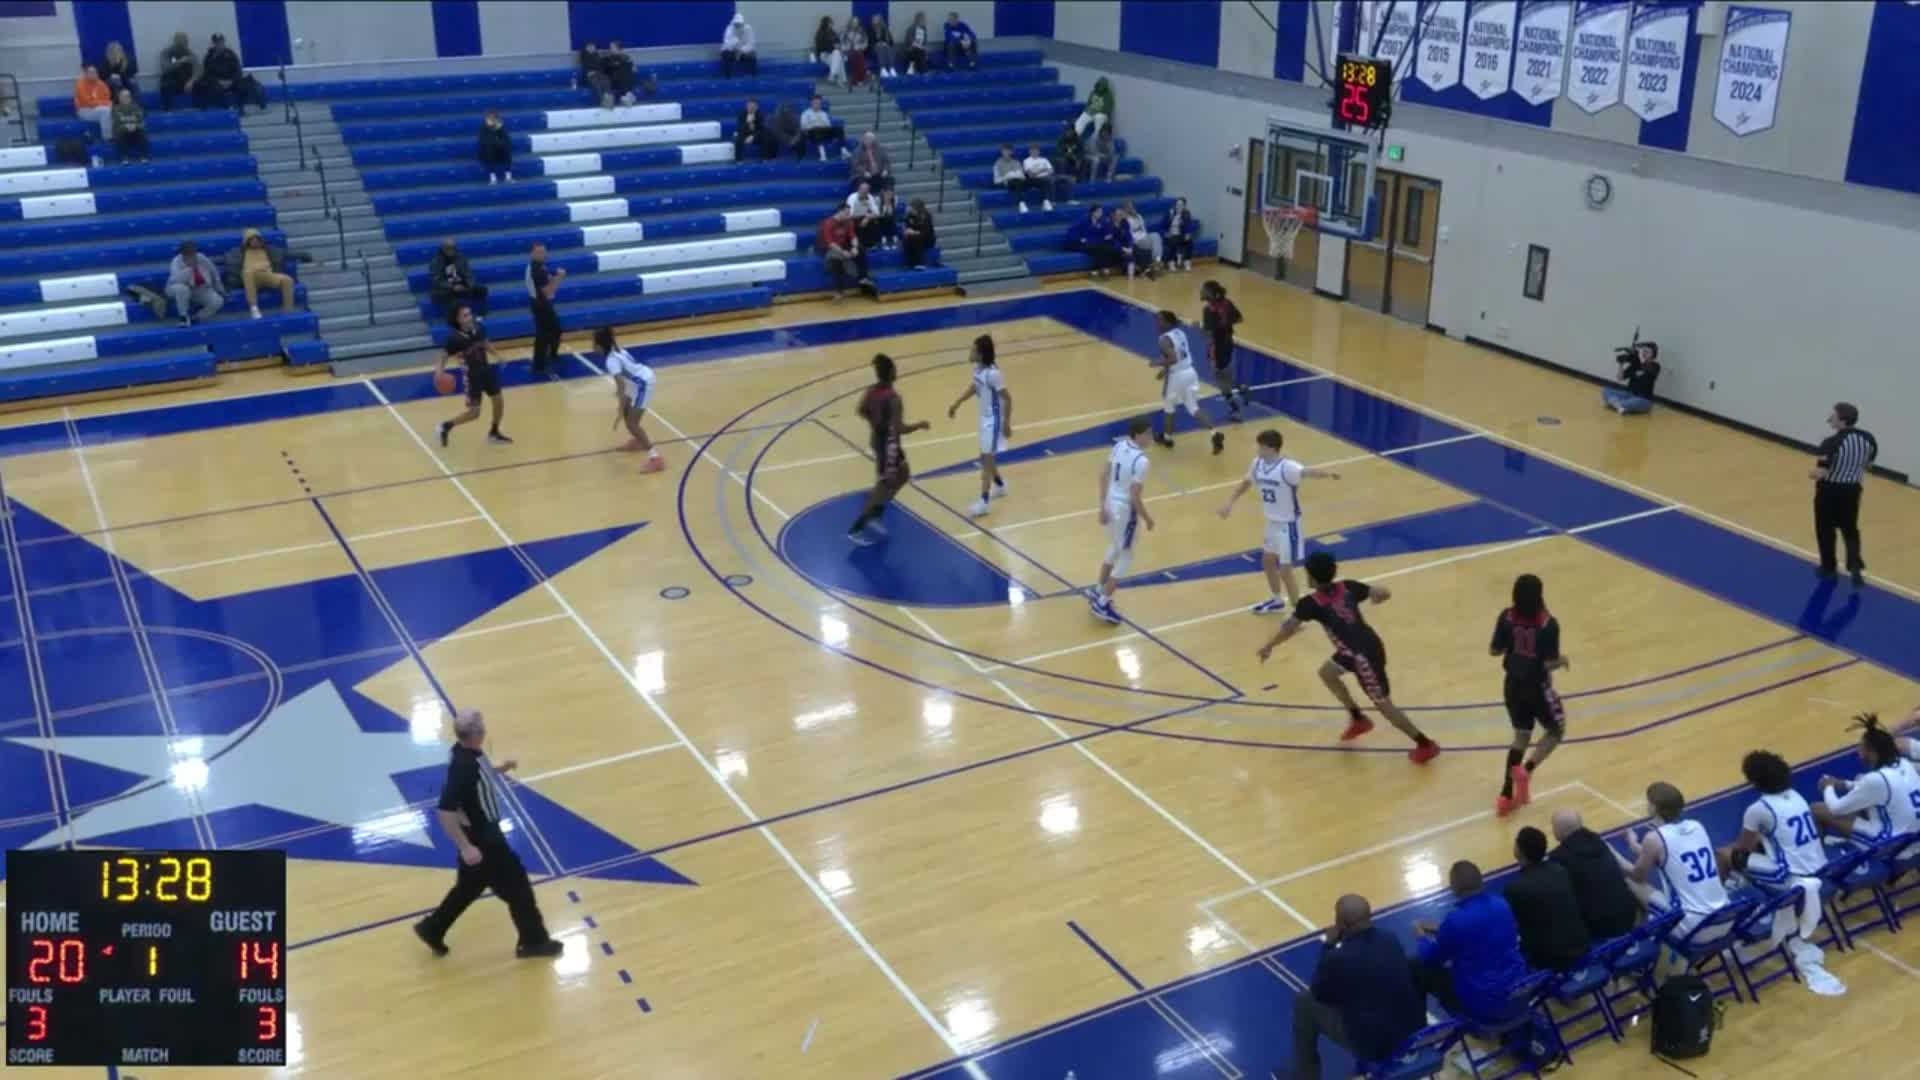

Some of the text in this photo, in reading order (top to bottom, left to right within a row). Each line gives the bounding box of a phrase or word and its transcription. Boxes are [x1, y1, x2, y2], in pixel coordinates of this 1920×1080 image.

[1473, 21, 1507, 37] NATIONAL
[1524, 26, 1561, 42] NATIONAL
[1518, 40, 1564, 57] CHAMPIONS
[1579, 33, 1617, 49] NATIONAL
[1635, 37, 1677, 55] NATIONAL
[1427, 44, 1451, 63] 2015
[1474, 51, 1499, 71] 2016
[1573, 45, 1621, 63] CHAMPIONS
[1629, 51, 1681, 71] CHAMPIONS
[1728, 43, 1775, 64] NATIONAL
[1342, 62, 1377, 87] 13:28
[1526, 58, 1552, 78] 2021
[1581, 65, 1609, 86] 2022
[1722, 58, 1779, 81] CHAMPIONS
[1638, 71, 1668, 93] 2023
[1729, 79, 1763, 103] 2024
[1341, 83, 1369, 121] 25
[1261, 488, 1277, 504] 23
[1681, 847, 1717, 883] 32
